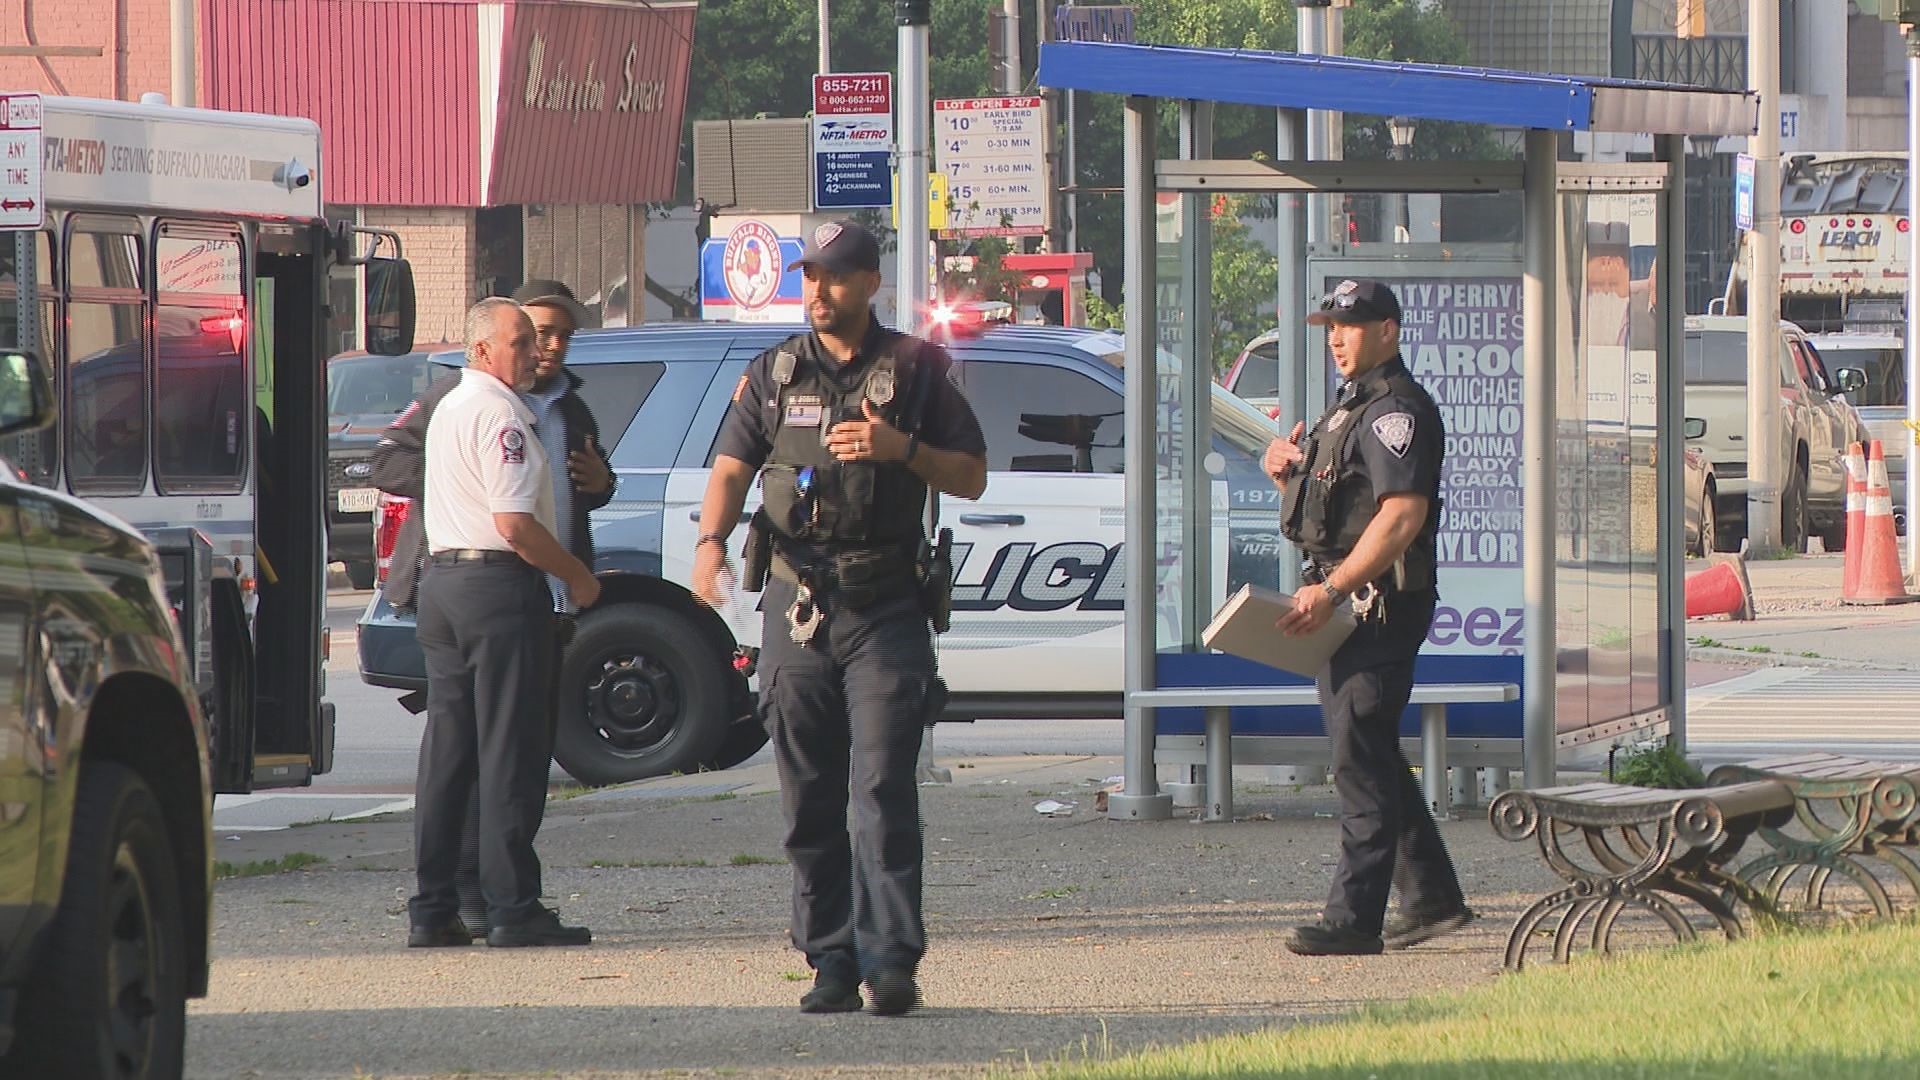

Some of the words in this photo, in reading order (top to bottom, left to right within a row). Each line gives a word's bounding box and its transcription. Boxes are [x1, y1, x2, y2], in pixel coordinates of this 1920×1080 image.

[822, 79, 882, 92] 855-7211
[828, 95, 886, 105] 800-662-1220
[944, 100, 966, 110] LOT
[972, 100, 1003, 109] OPEN
[1009, 99, 1032, 108] 24/7
[0, 102, 7, 125] O
[9, 103, 39, 121] STANDING
[984, 111, 1010, 119] EARLY
[1780, 111, 1798, 137] ET
[8, 142, 27, 160] ANY
[987, 140, 1008, 148] 0-30
[44, 137, 106, 175] FTA-METRO
[110, 145, 154, 174] SERVING
[156, 151, 201, 179] BUFFALO
[202, 153, 248, 181] NIAGARA
[827, 162, 836, 170] 16
[7, 168, 28, 185] TIME
[983, 165, 1010, 173] 31-60
[825, 172, 839, 183] 24
[825, 183, 839, 194] 42
[985, 207, 1018, 217] AFTER
[726, 224, 755, 267] BUFFALO
[756, 224, 780, 268] BISONS
[1820, 231, 1881, 247] LEACH
[1390, 284, 1433, 307] ATY
[1437, 284, 1513, 308] PERRY
[1400, 310, 1435, 324] RLIE
[1437, 312, 1508, 340] ADELE
[1399, 327, 1423, 342] UTH
[1438, 405, 1521, 434] RUNO
[1445, 436, 1517, 457] DONNA
[1452, 457, 1513, 472] LADY
[1449, 473, 1516, 487] GAGA
[1449, 489, 1499, 509] KELLY
[1450, 510, 1522, 531] BACKSTR
[1436, 532, 1518, 562] AYLOR
[950, 541, 1125, 612] LIC
